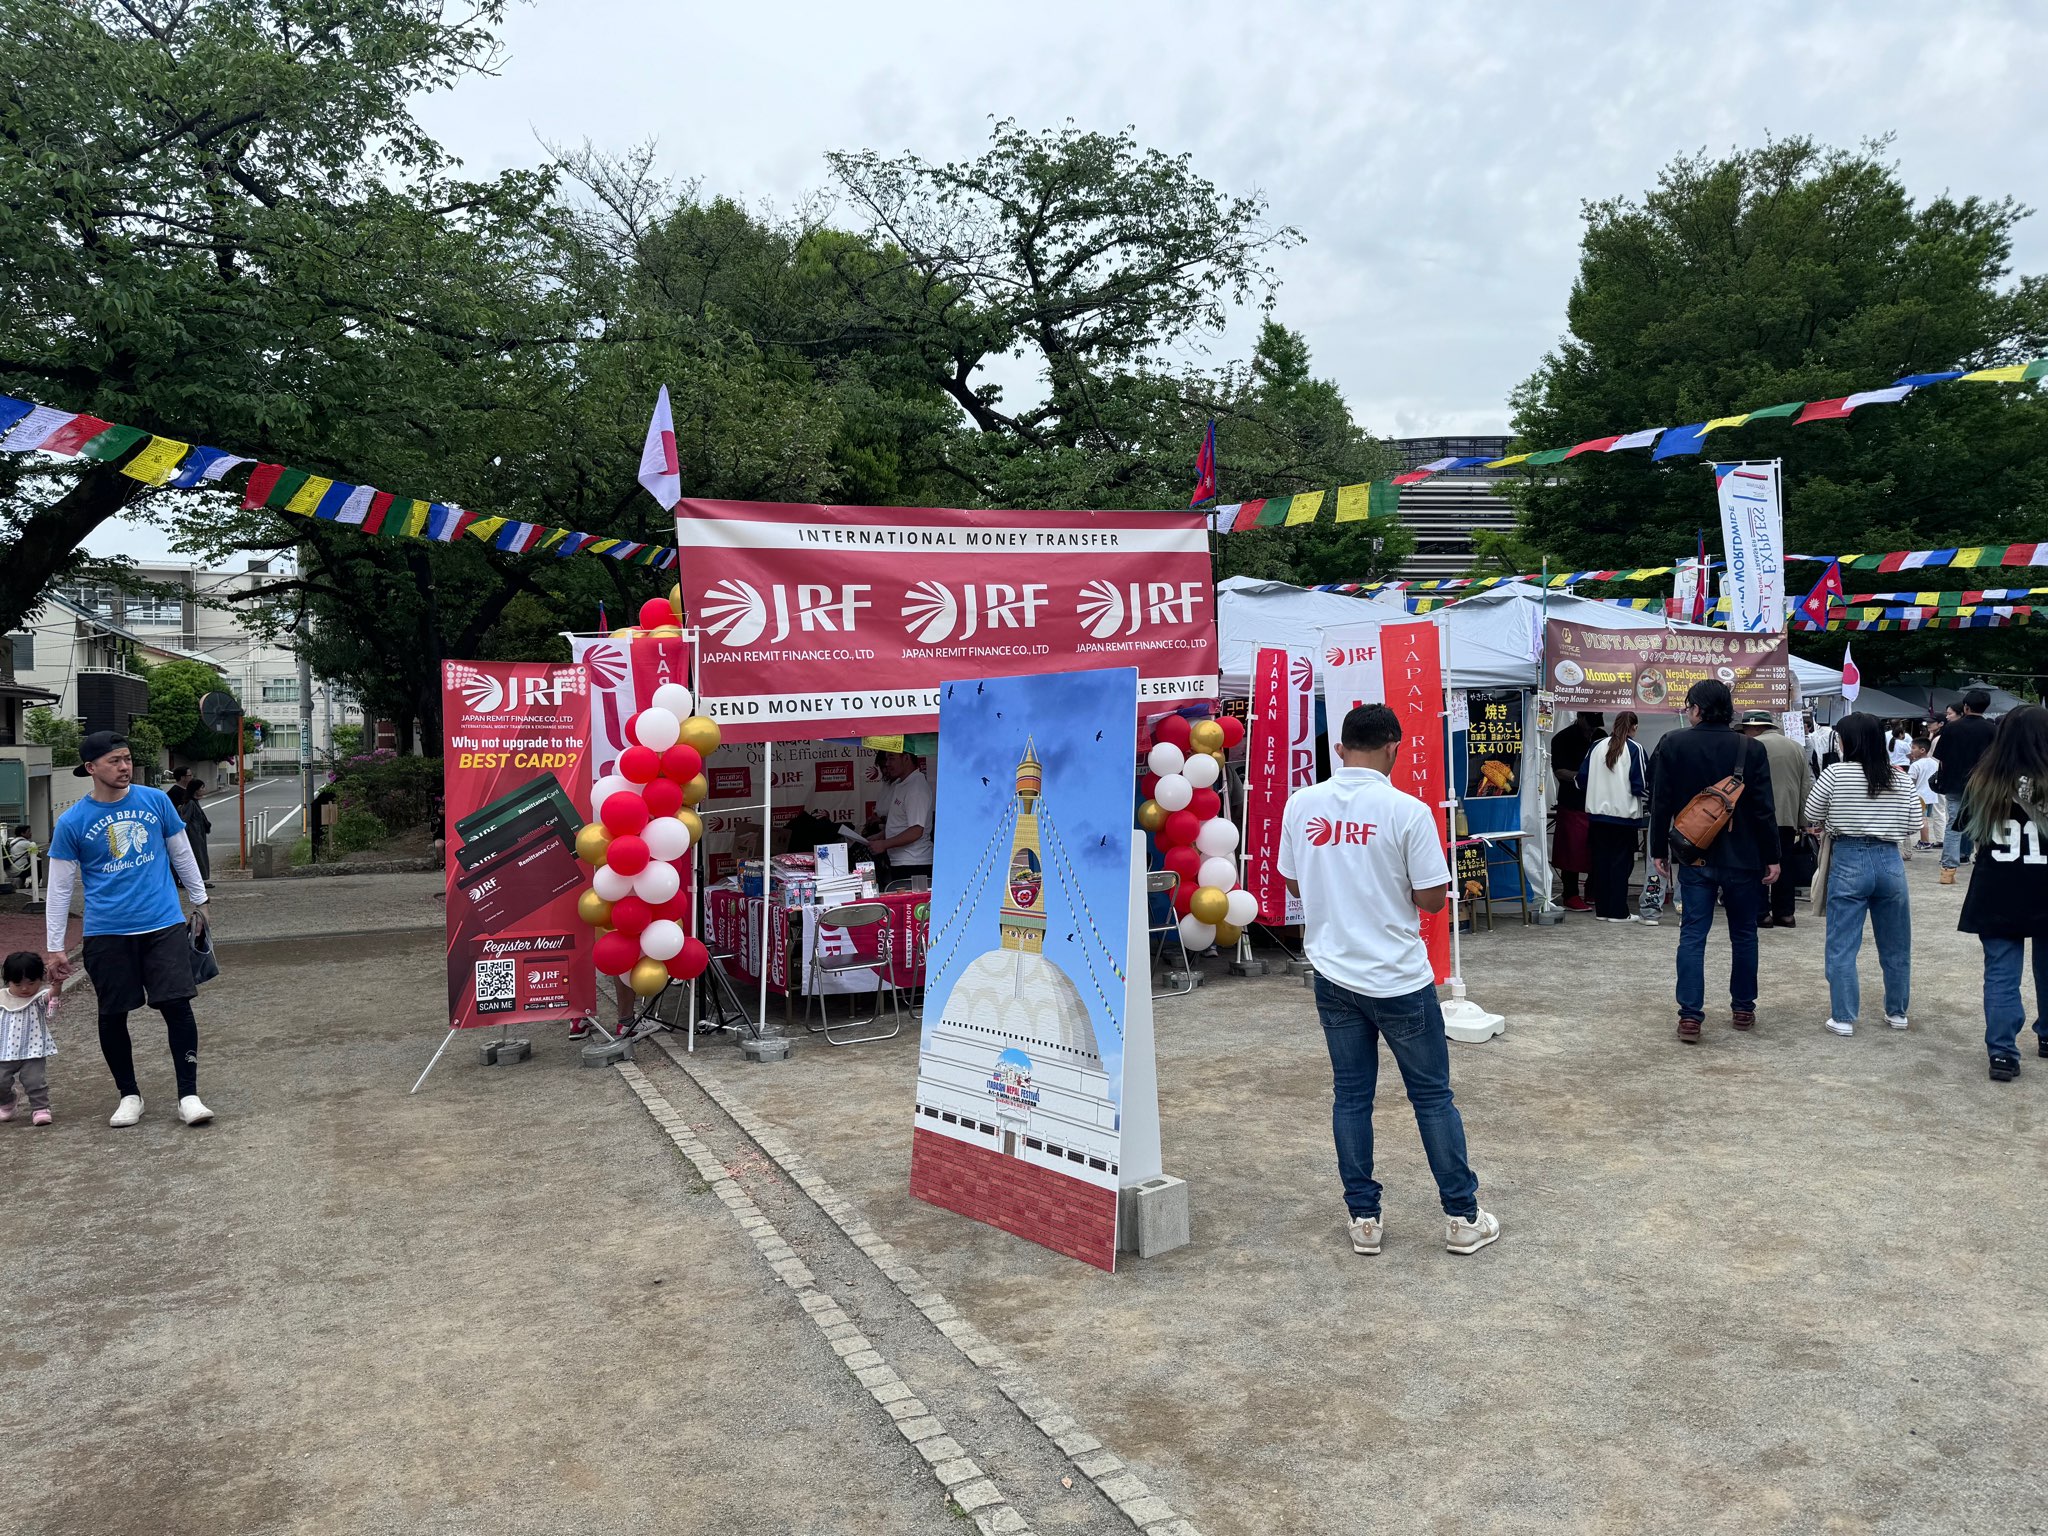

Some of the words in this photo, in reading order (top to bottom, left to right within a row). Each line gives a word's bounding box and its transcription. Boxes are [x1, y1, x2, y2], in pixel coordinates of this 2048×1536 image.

[799, 529, 956, 545] INTERNATIONAL
[966, 533, 1028, 546] MONEY
[1036, 533, 1119, 546] TRANSFER
[771, 584, 872, 644] JRF
[959, 583, 1048, 641] JRF
[1126, 582, 1203, 636] JRF
[1076, 642, 1105, 653] JAPAN
[1106, 641, 1133, 652] REMIT
[1135, 640, 1173, 651] FINANCE
[1192, 638, 1207, 648] LTD
[1581, 631, 1663, 651] VINTAGE
[1665, 634, 1725, 653] DINING
[702, 651, 742, 664] JAPAN
[744, 650, 780, 662] REMIT
[783, 649, 831, 661] FINANCE
[855, 648, 875, 660] LTD
[901, 647, 934, 659] JAPAN
[936, 646, 967, 658] REMIT
[969, 646, 1010, 656] FINANCE
[1033, 644, 1049, 655] LTD
[1348, 646, 1377, 666] JRF
[1403, 634, 1424, 714] JAPAN
[1583, 667, 1617, 682] Momo
[1616, 672, 1633, 683] モモ
[1665, 668, 1685, 680] Nepal
[1685, 669, 1708, 681] Special
[504, 677, 573, 712] JRF
[1153, 680, 1204, 694] SERVICE
[1268, 653, 1279, 721] JAPAN
[1555, 685, 1575, 694] Steam
[1575, 686, 1594, 695] Momo
[1618, 688, 1633, 696] ¥500
[1667, 681, 1688, 694] Khaja
[1771, 683, 1787, 691] ¥500
[709, 701, 760, 717] SEND
[768, 698, 834, 714] MONEY
[841, 697, 863, 710] TO
[870, 694, 917, 709] YOUR
[1470, 693, 1493, 701] やきたて
[1554, 694, 1570, 704] Soup
[1570, 695, 1589, 704] Momo
[1616, 697, 1632, 705] ¥600
[461, 715, 485, 723] JAPAN
[511, 715, 544, 723] FINANCE
[1485, 703, 1508, 720] 焼き
[1469, 721, 1521, 733] とうもろこし
[451, 736, 478, 750] Why
[481, 737, 500, 748] not
[502, 736, 549, 751] upgrade
[551, 737, 563, 748] to
[565, 736, 583, 748] the
[1469, 741, 1522, 755] 1本400円
[459, 753, 510, 769] BEST
[514, 752, 578, 769] CARD?
[790, 747, 838, 760] Efficient
[840, 746, 851, 758] &
[1263, 736, 1276, 803] REMIT
[1411, 735, 1428, 798] REMI
[781, 771, 804, 785] JRF
[518, 796, 547, 815] Remittance
[546, 789, 560, 799] Card
[545, 816, 559, 827] Card
[833, 809, 855, 822] JRF
[85, 814, 115, 841] FITCH
[116, 810, 158, 824] BRAVES
[1331, 820, 1377, 846] JRF
[1991, 819, 2048, 865] 91
[518, 848, 547, 867] Remittance
[546, 840, 560, 851] Card
[101, 860, 134, 874] Athletic
[135, 851, 155, 866] Club
[1260, 818, 1271, 913] FINANCE
[480, 877, 498, 895] JRF
[482, 940, 531, 958] Register
[533, 936, 565, 950] Now!
[542, 970, 560, 981] JRF
[529, 982, 558, 990] WALLET
[479, 1002, 499, 1011] SCAN
[501, 1000, 513, 1009] ME
[1006, 1084, 1020, 1097] NEPAL
[1020, 1087, 1041, 1103] FESTIVAL
